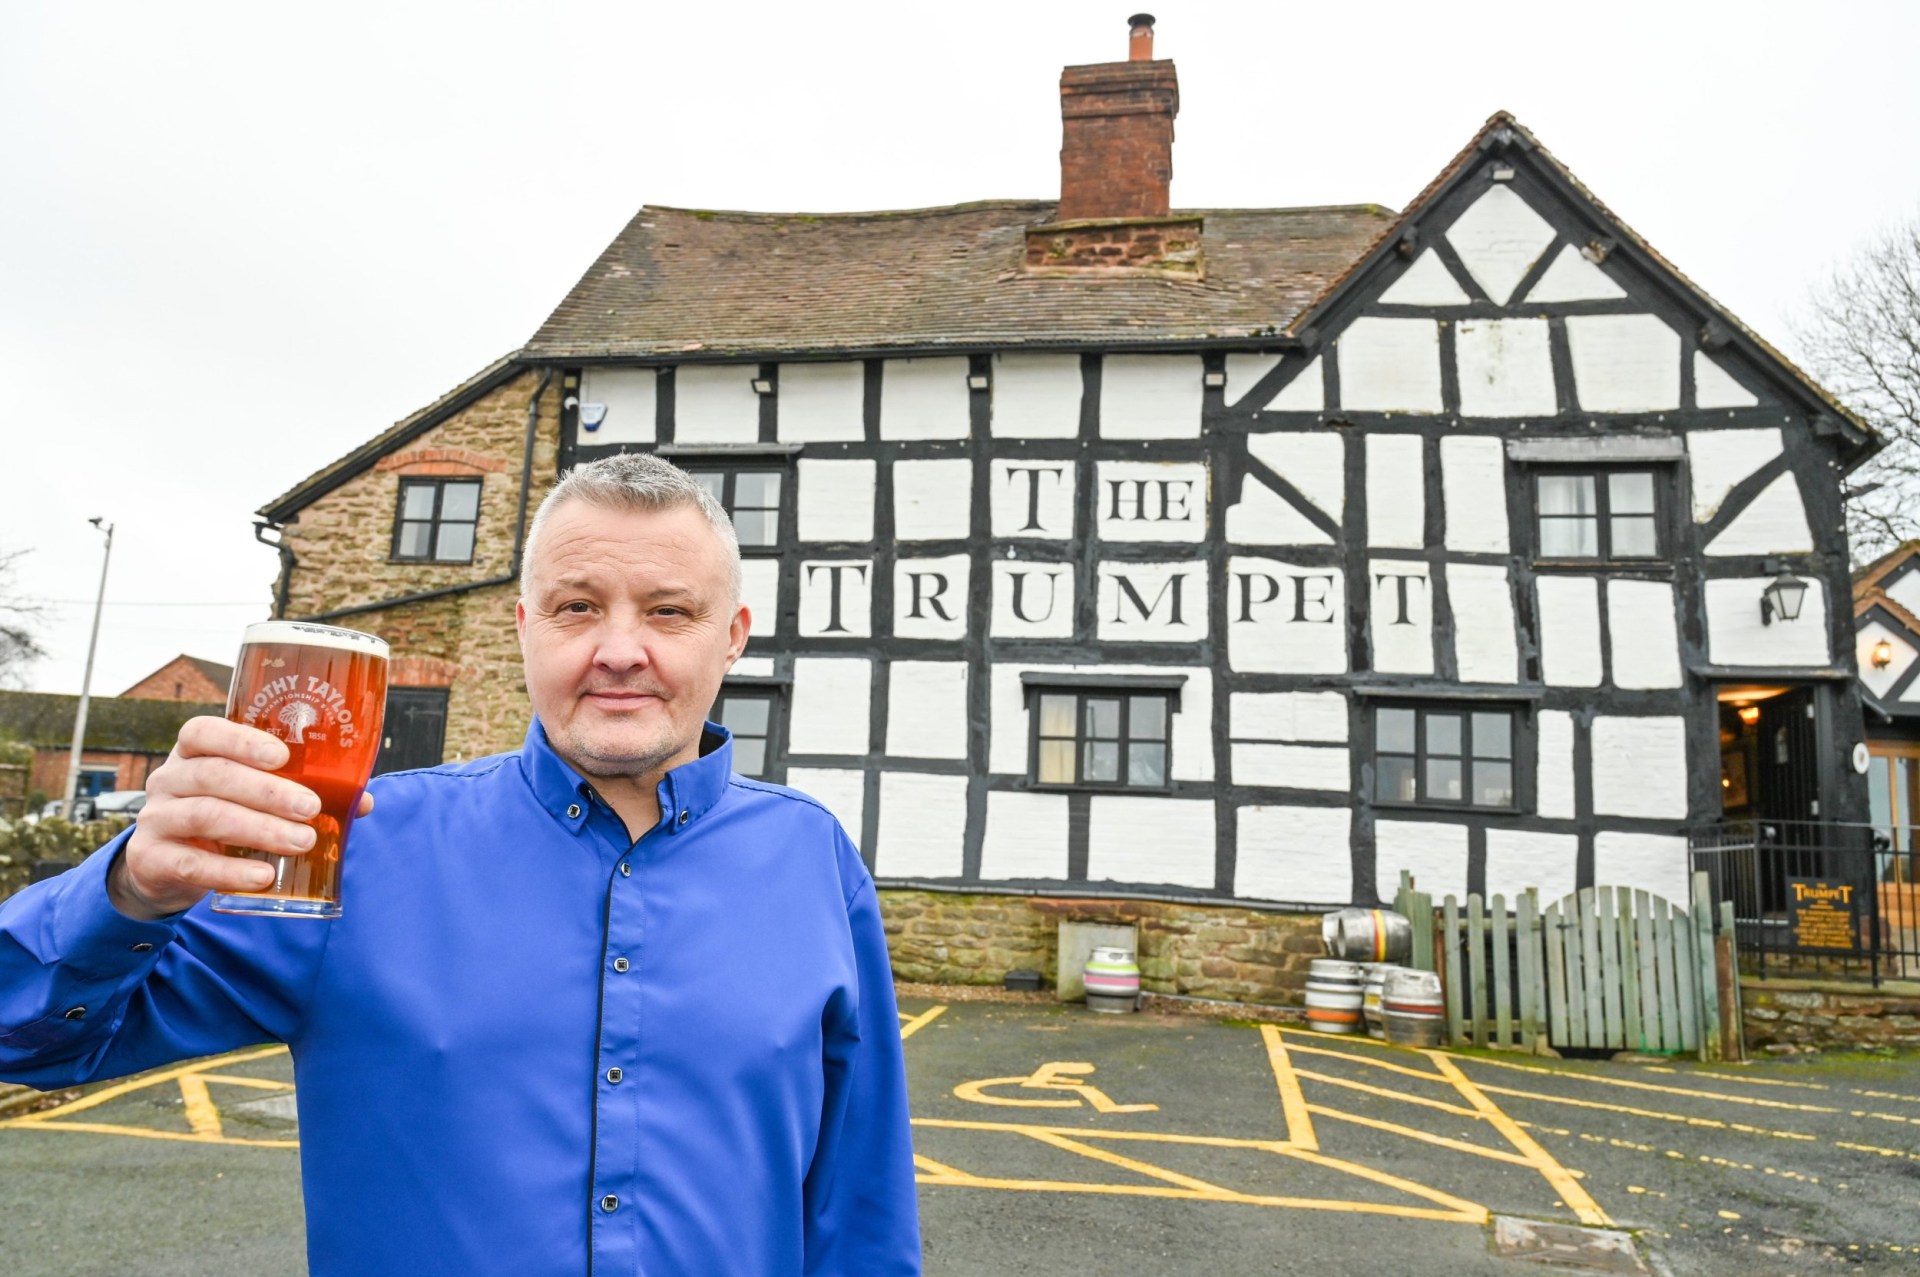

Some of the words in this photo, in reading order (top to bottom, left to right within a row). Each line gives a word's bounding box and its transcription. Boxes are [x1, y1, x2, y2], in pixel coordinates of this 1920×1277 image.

[1006, 467, 1194, 532] THE
[806, 564, 1427, 634] TRUMPET
[244, 675, 299, 727] MOTHY
[262, 693, 320, 719] CHAMPIONSHIP
[308, 732, 327, 741] 1858
